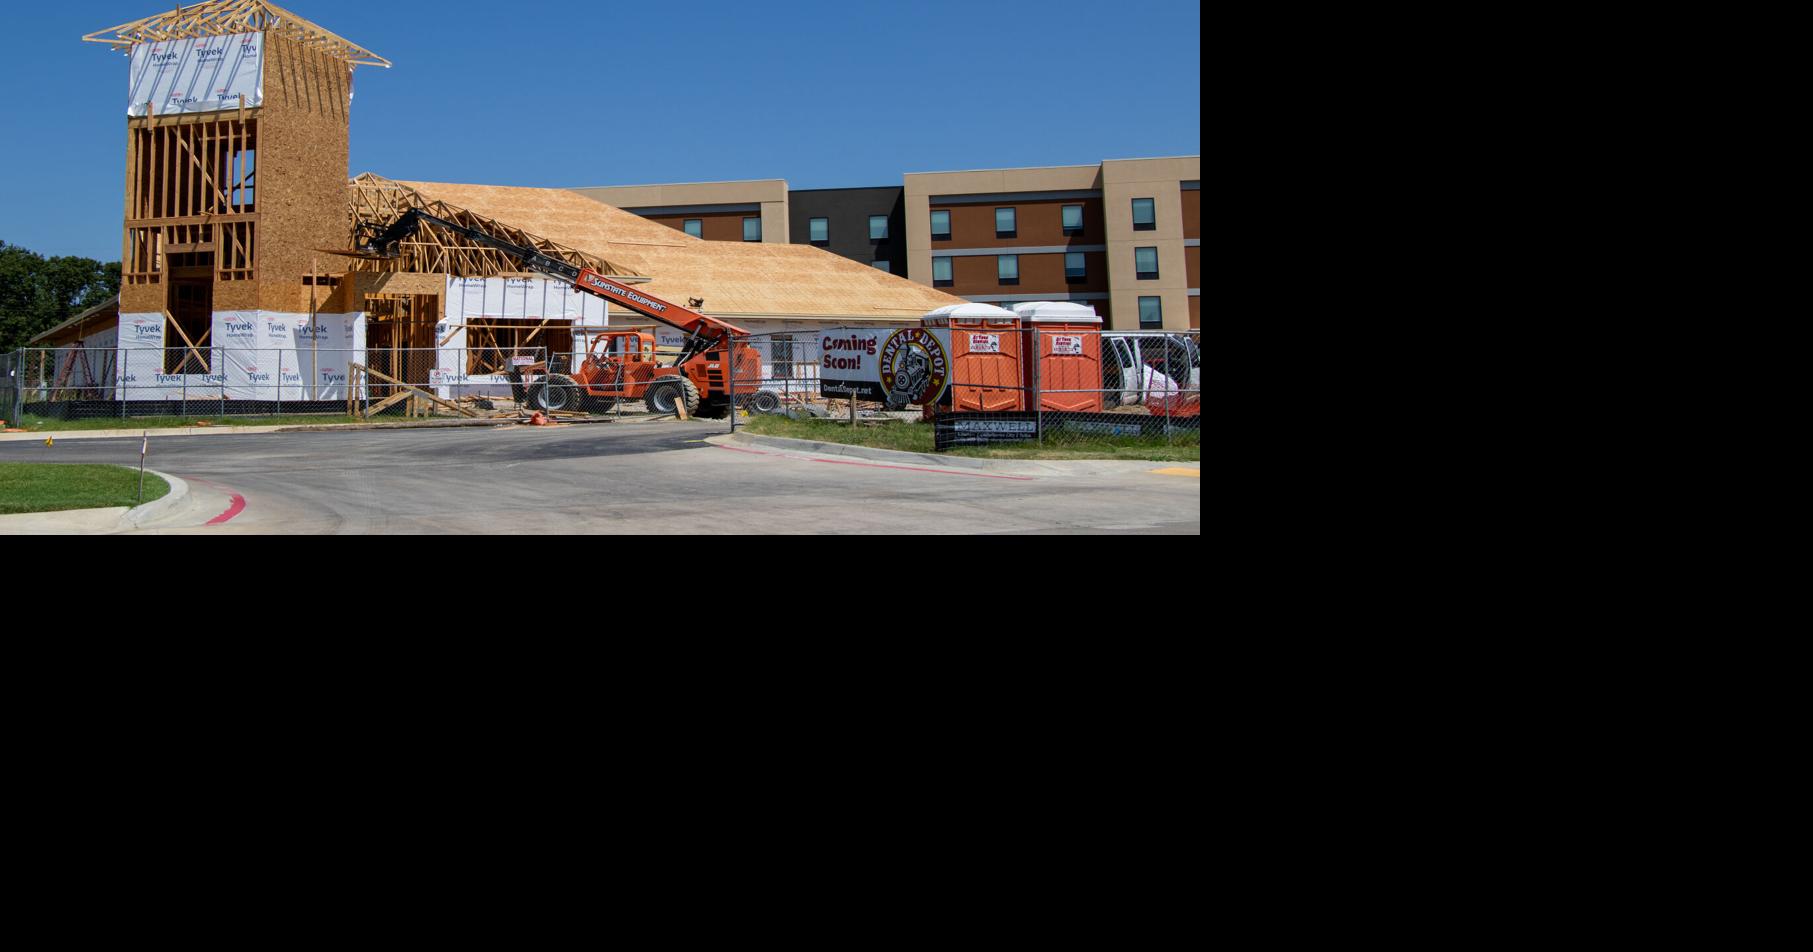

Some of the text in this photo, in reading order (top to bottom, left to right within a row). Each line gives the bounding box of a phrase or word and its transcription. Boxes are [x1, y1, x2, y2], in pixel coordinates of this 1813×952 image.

[196, 48, 223, 57] Tyvek
[241, 44, 256, 53] Tyv
[151, 52, 177, 62] Tyvek
[591, 276, 667, 313] SUNSTATE EQUIPMENT
[134, 324, 160, 334] Tyvek
[225, 322, 253, 333] Tyvek
[268, 322, 286, 332] Tyvek
[882, 330, 945, 377] DENTAL DEPOT
[117, 374, 136, 382] yvek
[155, 373, 181, 383] Tyvek
[202, 373, 228, 383] Tyvek
[249, 373, 270, 383] Tyvek
[323, 373, 346, 382] Tyve
[959, 421, 1034, 432] MAXWELL
